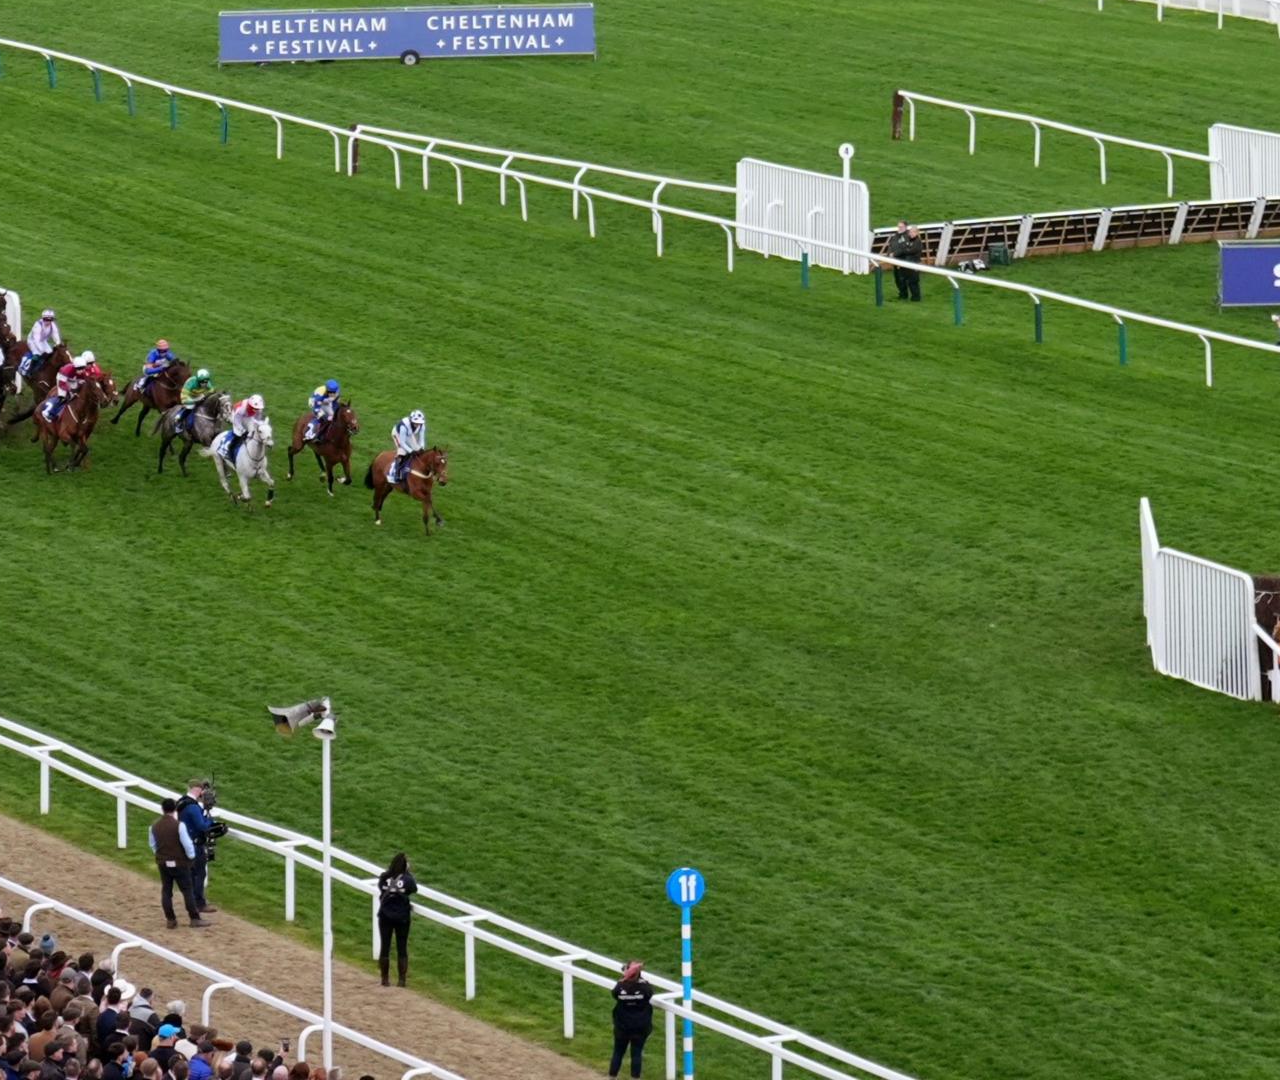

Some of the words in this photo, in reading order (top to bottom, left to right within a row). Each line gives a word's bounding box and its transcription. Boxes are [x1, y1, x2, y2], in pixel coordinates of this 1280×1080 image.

[239, 17, 387, 35] CHELTENHAM
[426, 13, 574, 31] CHELTENHAM
[265, 38, 364, 55] FESTIVAL
[452, 35, 551, 51] FESTIVAL
[678, 874, 697, 902] 1f
